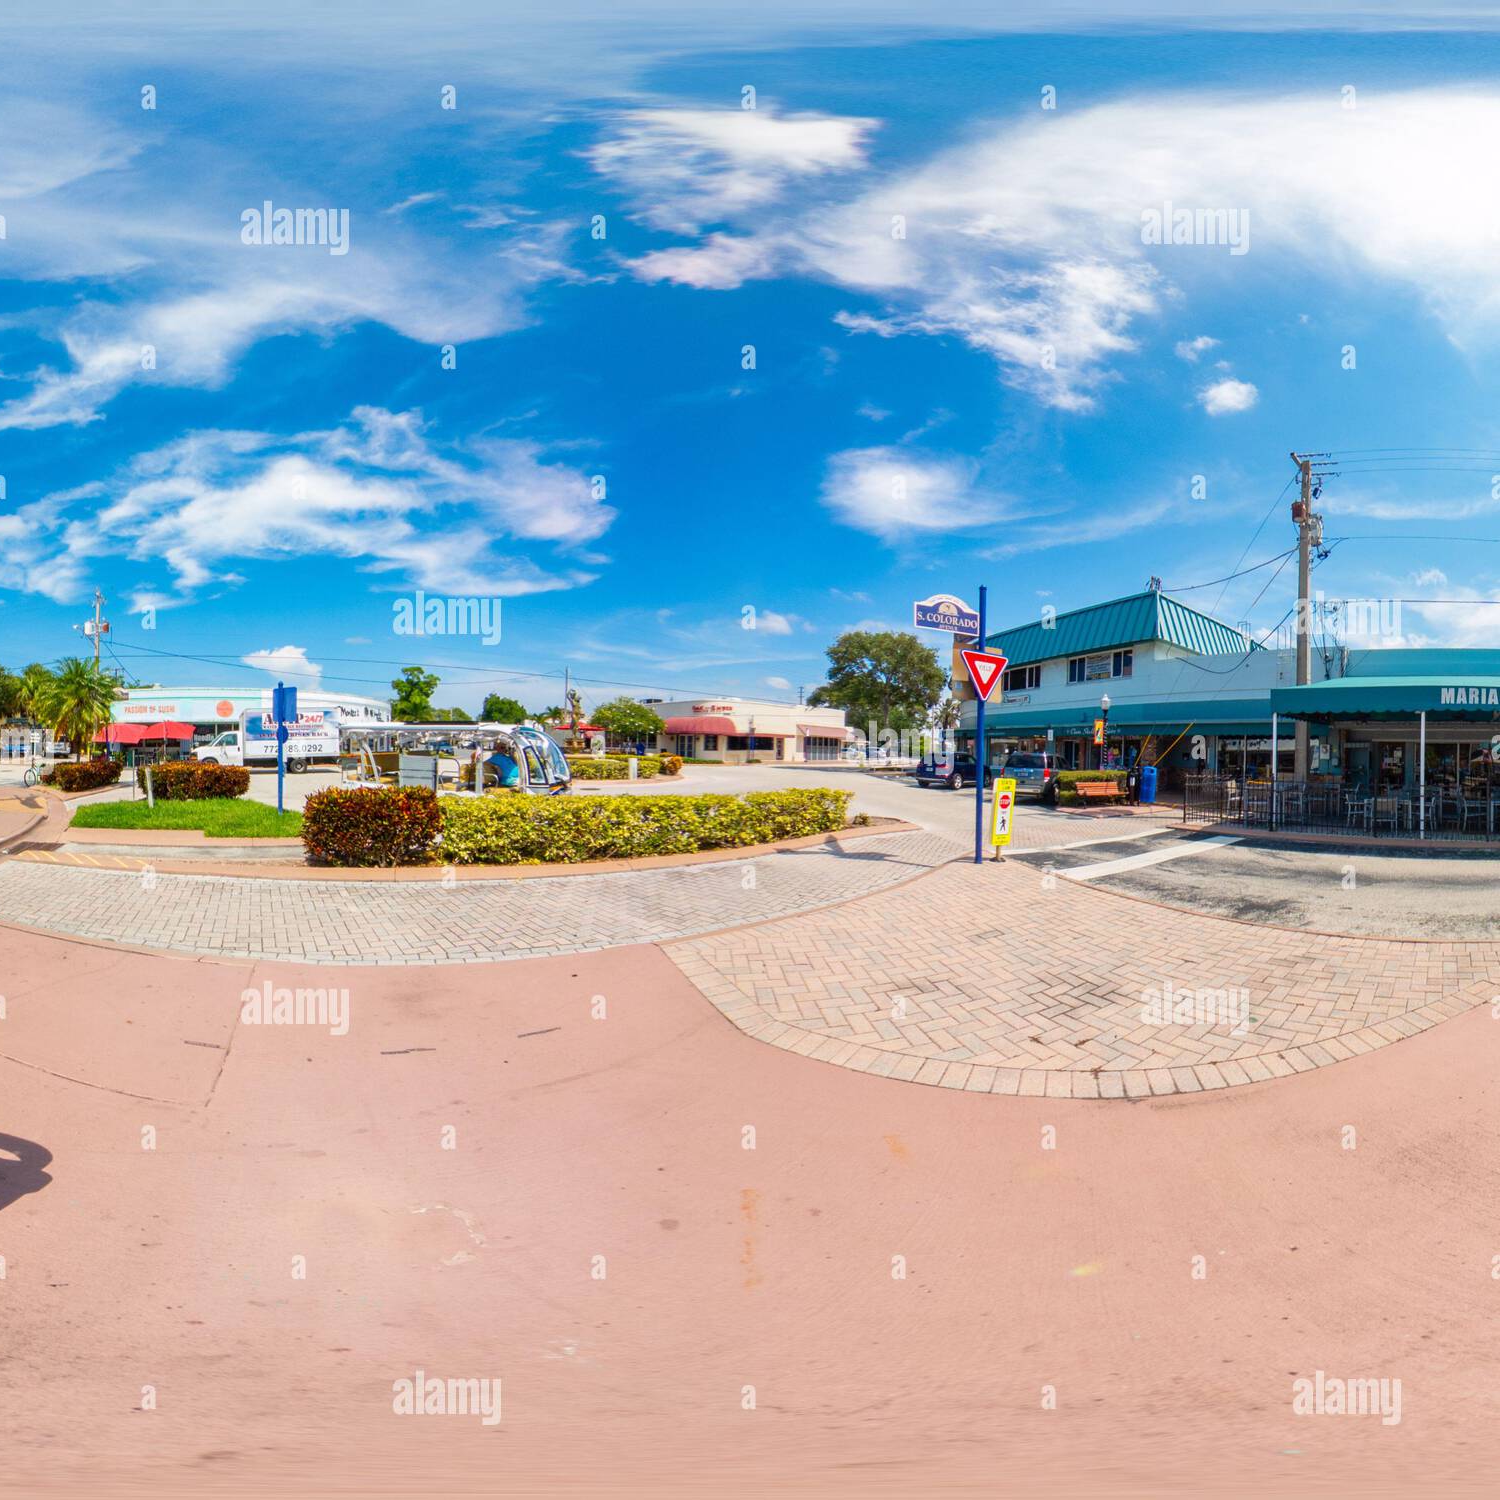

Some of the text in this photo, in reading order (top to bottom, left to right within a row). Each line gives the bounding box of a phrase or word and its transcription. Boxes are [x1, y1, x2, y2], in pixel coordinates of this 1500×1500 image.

[917, 611, 978, 630] S. COLORADO
[1440, 687, 1499, 705] MARIA
[263, 713, 324, 725] AP 24/7
